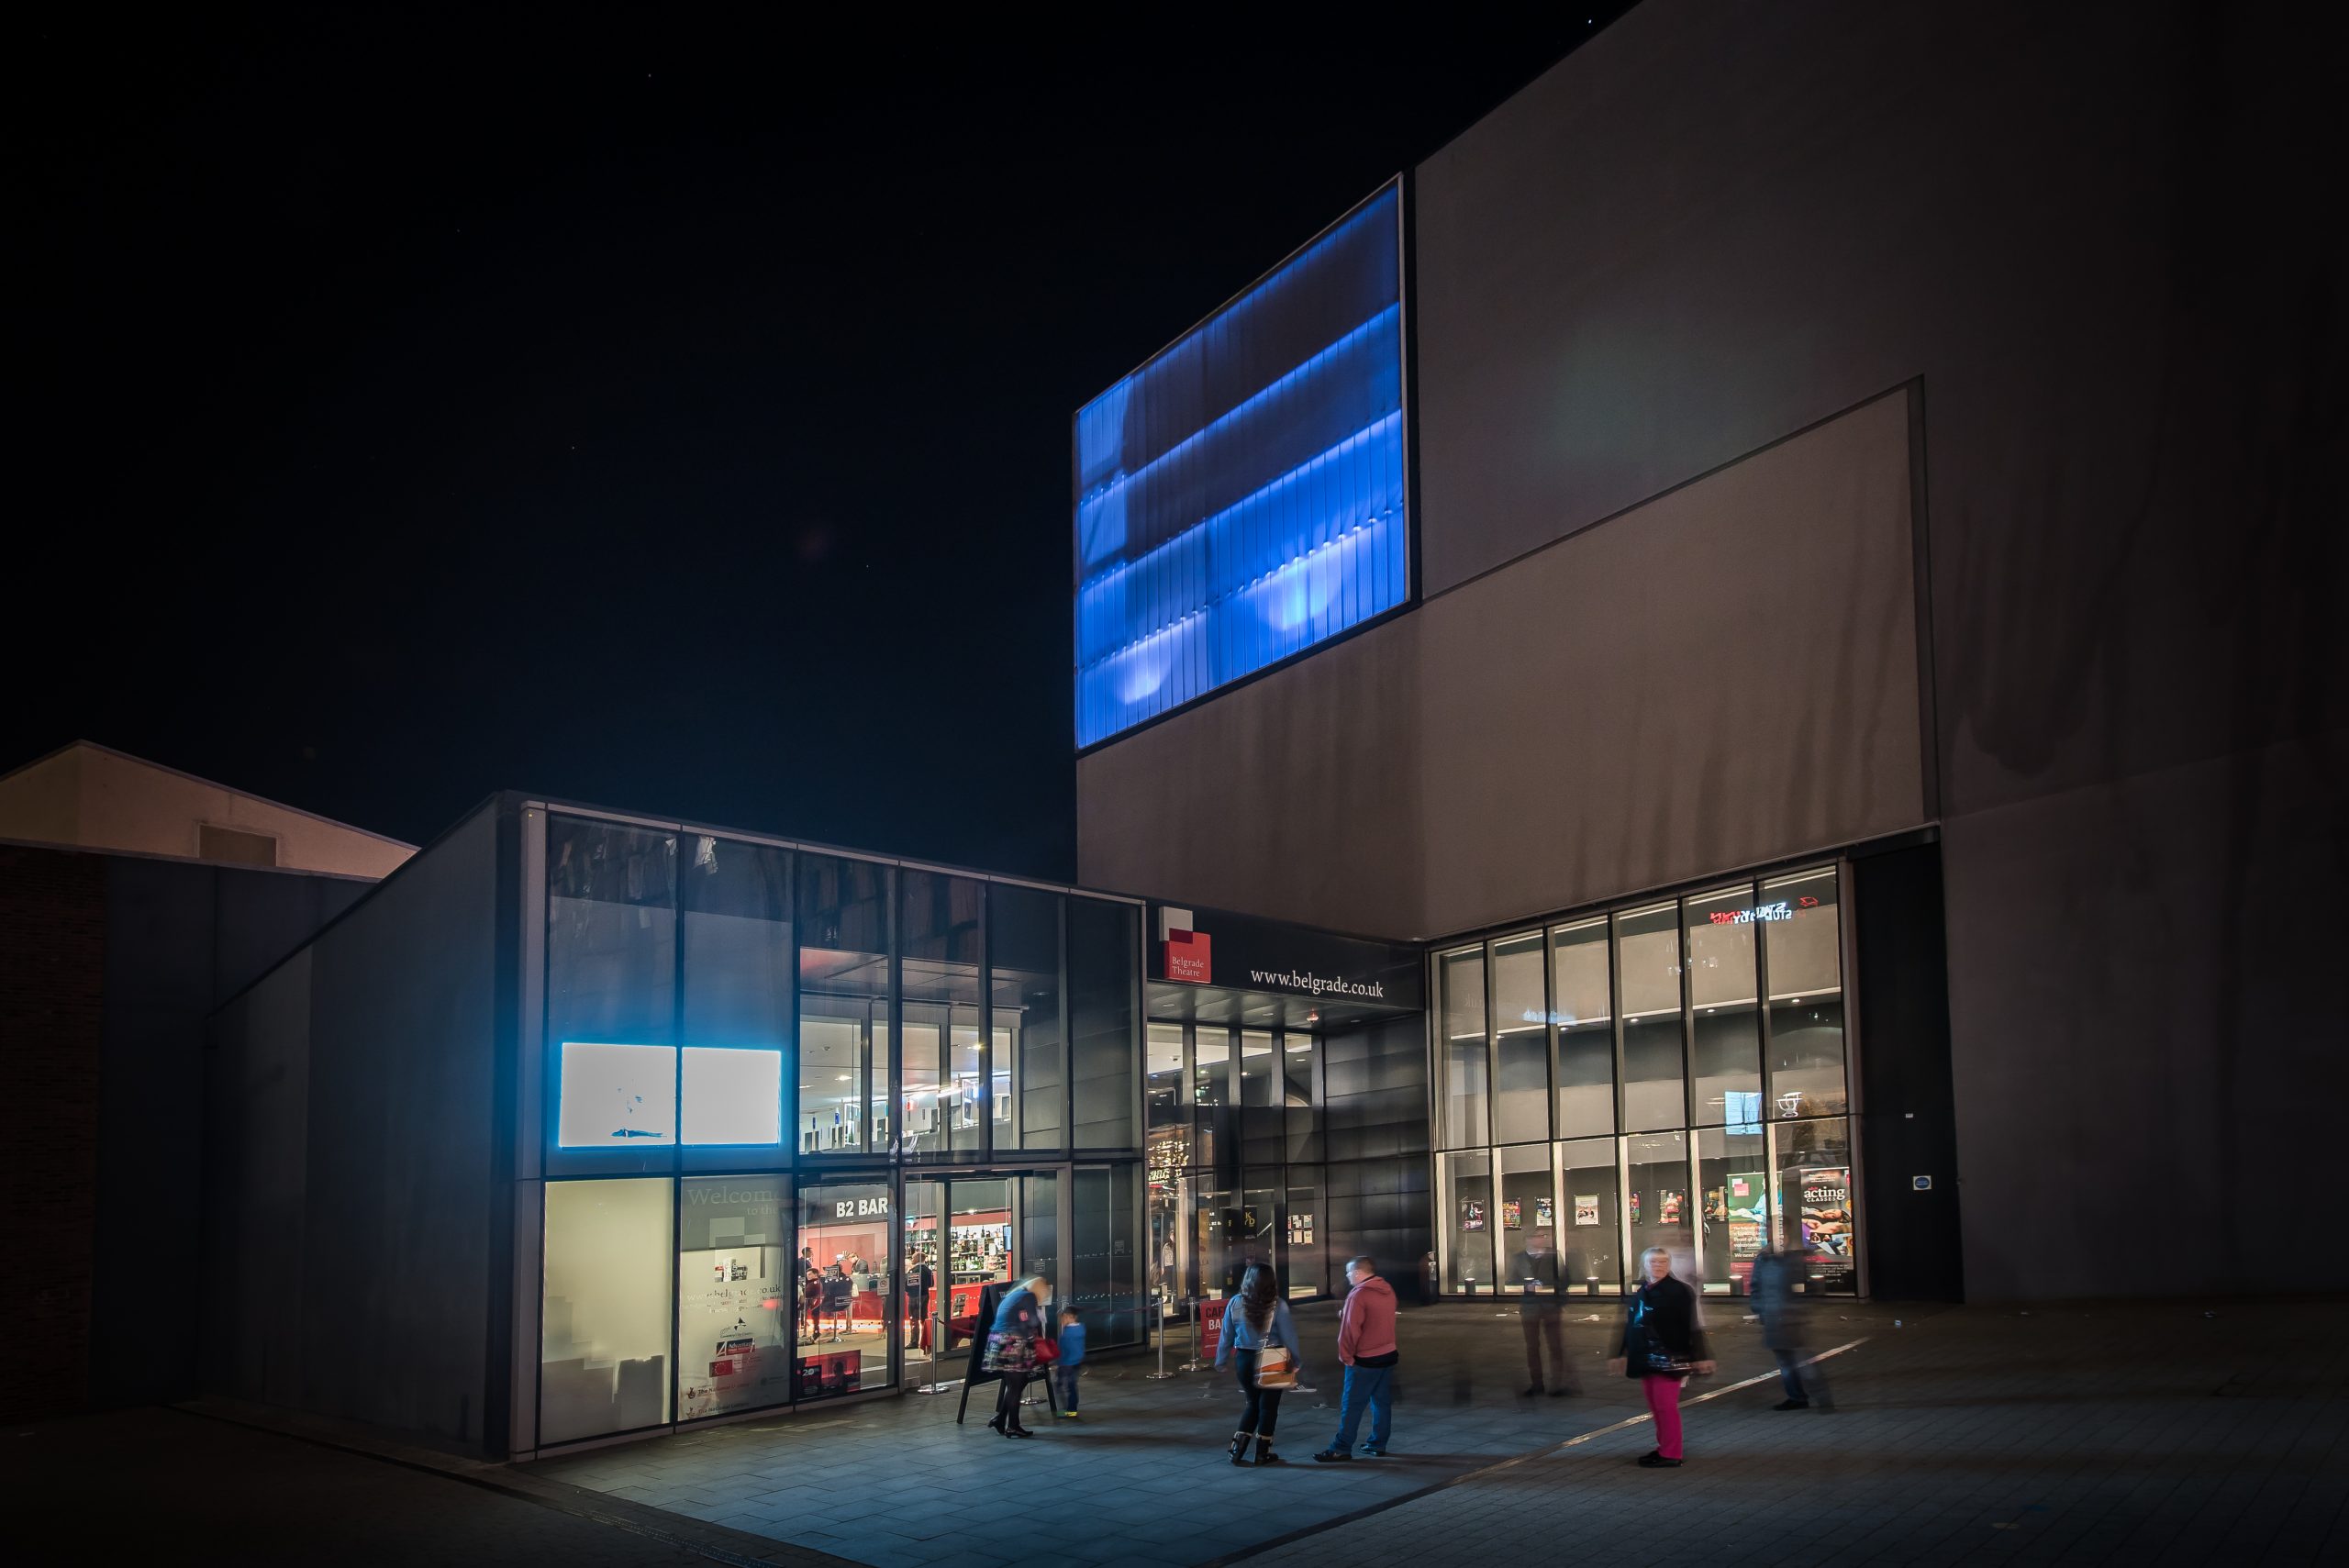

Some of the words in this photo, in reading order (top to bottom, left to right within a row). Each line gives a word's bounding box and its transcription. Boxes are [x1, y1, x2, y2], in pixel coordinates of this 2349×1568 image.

[1172, 956, 1205, 969] Belgrade
[1172, 966, 1201, 978] Theatre
[1250, 969, 1384, 998] www.belgrade.co.uk
[1803, 1185, 1846, 1201] acting
[836, 1200, 854, 1218] B2
[858, 1196, 888, 1216] BAR
[1205, 1307, 1226, 1318] CAF
